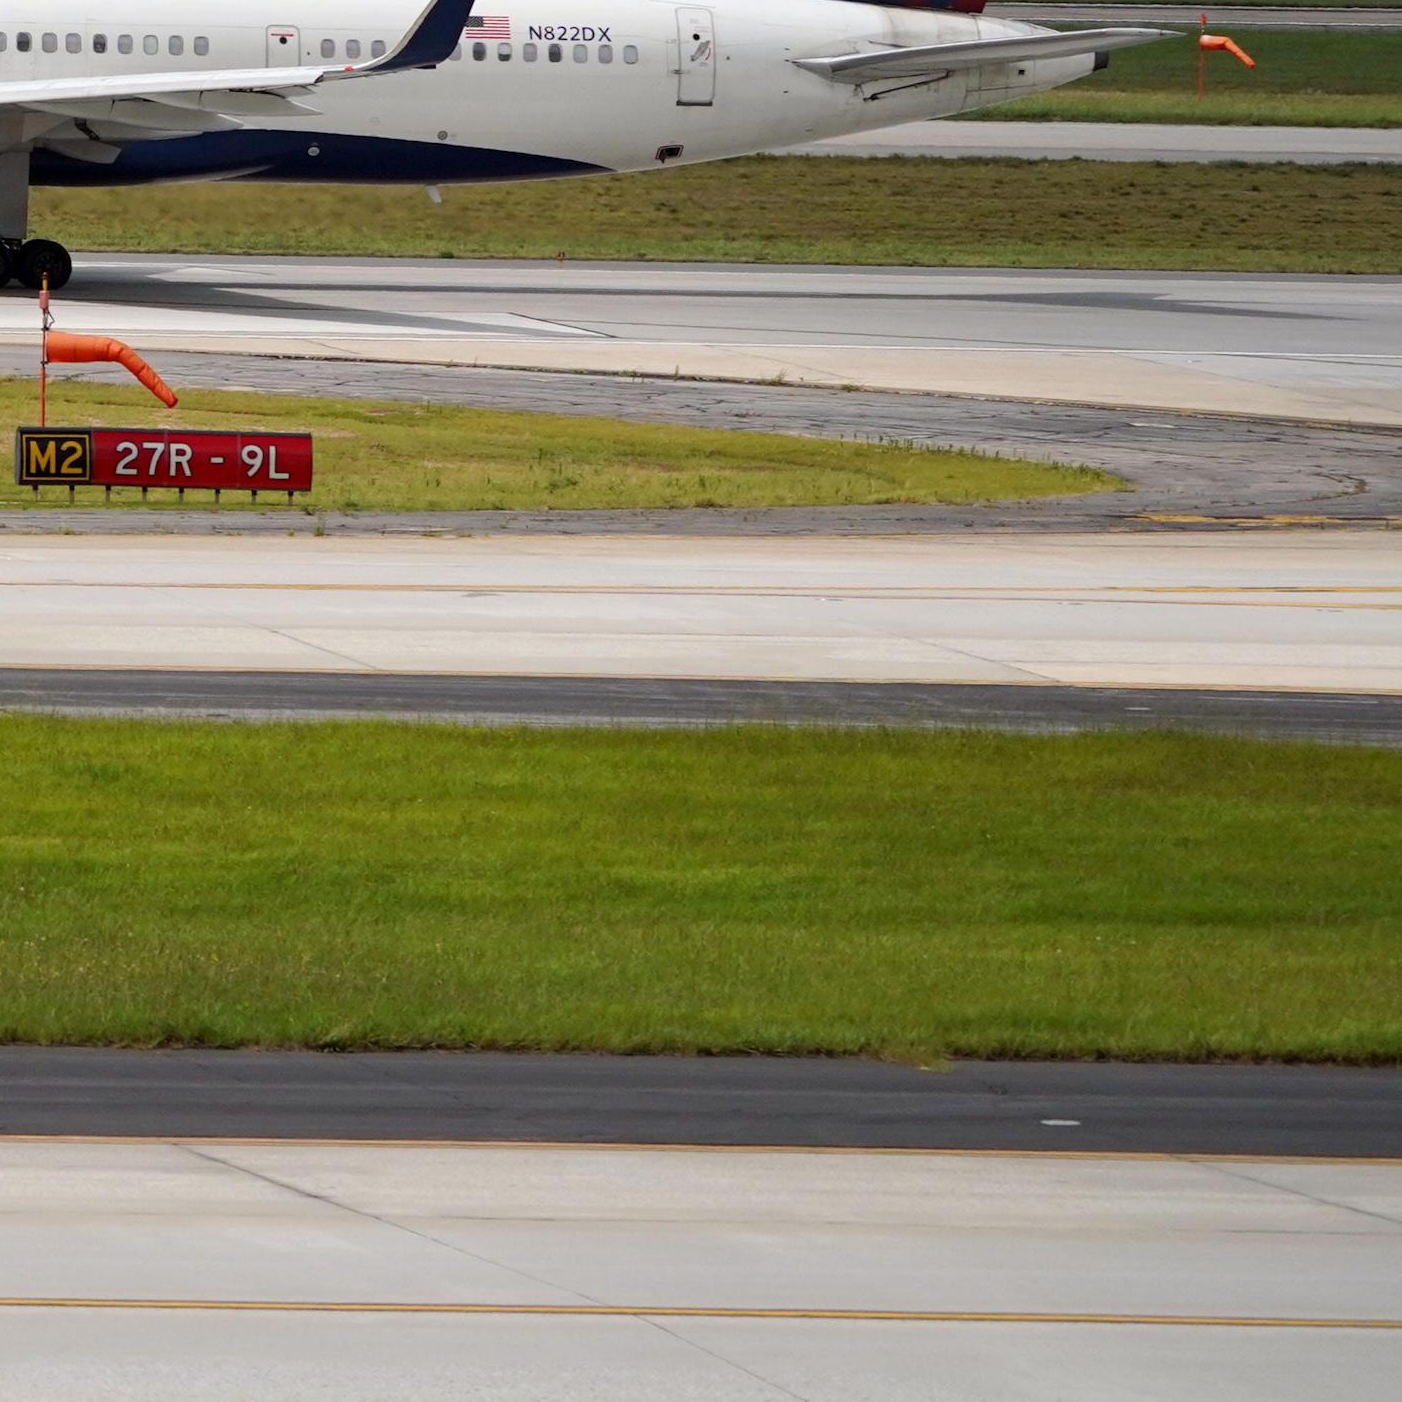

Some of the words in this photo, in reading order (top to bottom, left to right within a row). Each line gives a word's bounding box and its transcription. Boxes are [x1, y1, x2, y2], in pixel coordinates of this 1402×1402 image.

[528, 25, 612, 43] N822DX
[29, 441, 83, 475] M2
[115, 441, 193, 478] 27R
[240, 444, 290, 481] 9L
